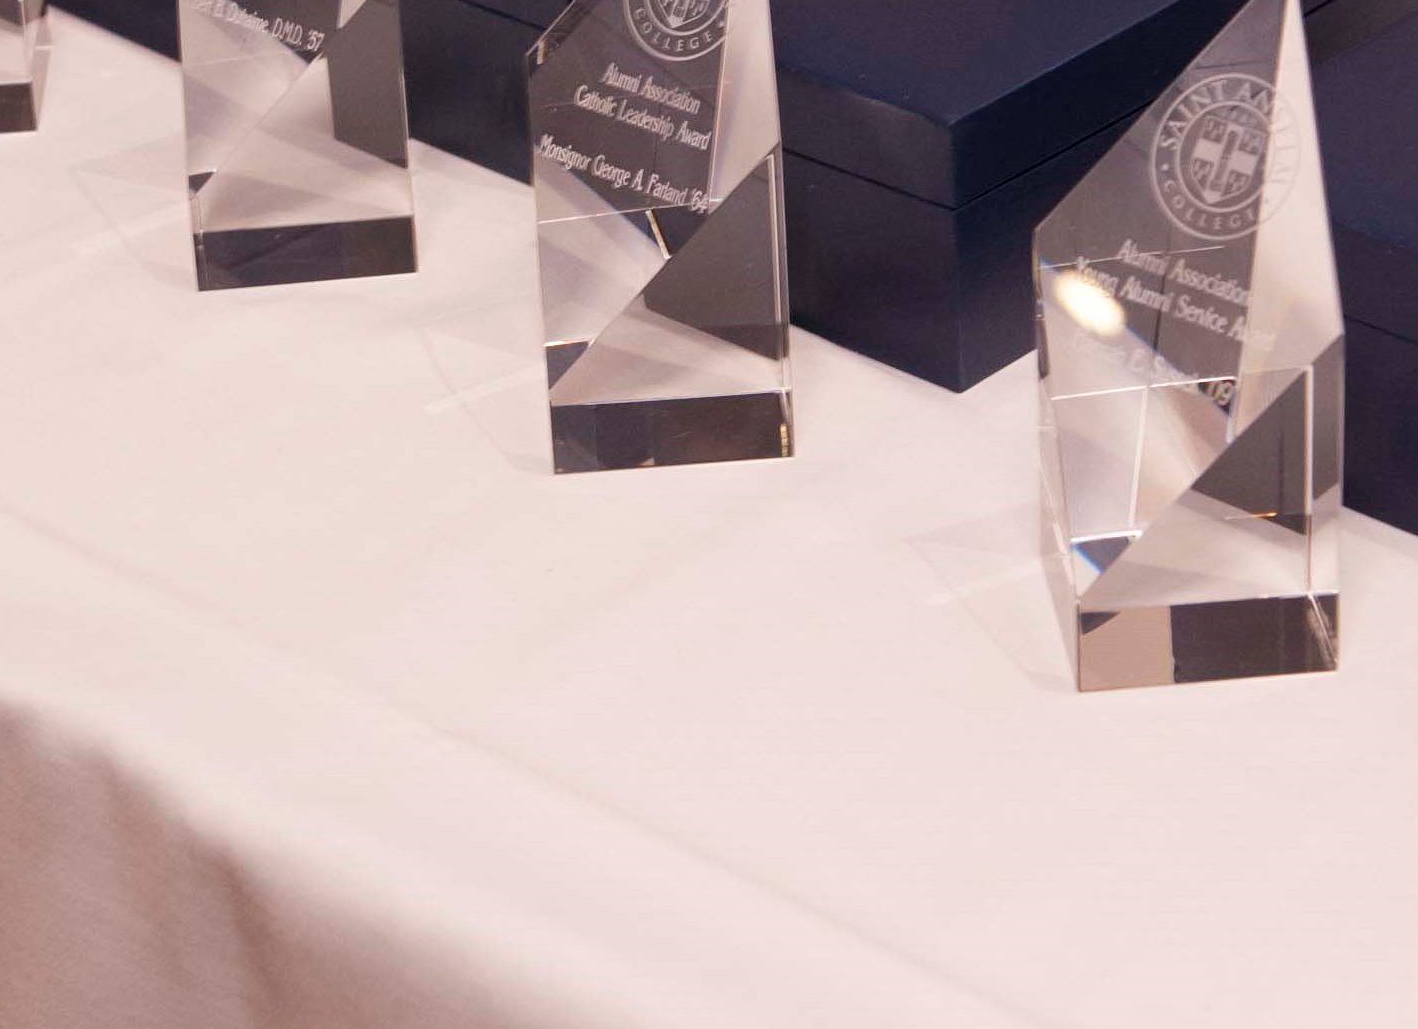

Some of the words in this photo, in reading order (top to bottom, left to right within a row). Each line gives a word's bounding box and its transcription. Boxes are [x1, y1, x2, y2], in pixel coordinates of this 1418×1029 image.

[634, 8, 714, 52] COLLEGE
[602, 62, 641, 93] Alumni
[641, 76, 701, 114] Association
[1161, 78, 1229, 149] SAINT
[573, 85, 617, 118] Catholic
[618, 100, 676, 142] Leadership
[676, 118, 712, 151] Award
[539, 134, 593, 172] Monsignor
[594, 155, 631, 189] George
[1116, 238, 1171, 277] Alumni
[1119, 274, 1175, 315] Alumni
[1175, 294, 1226, 335] Service
